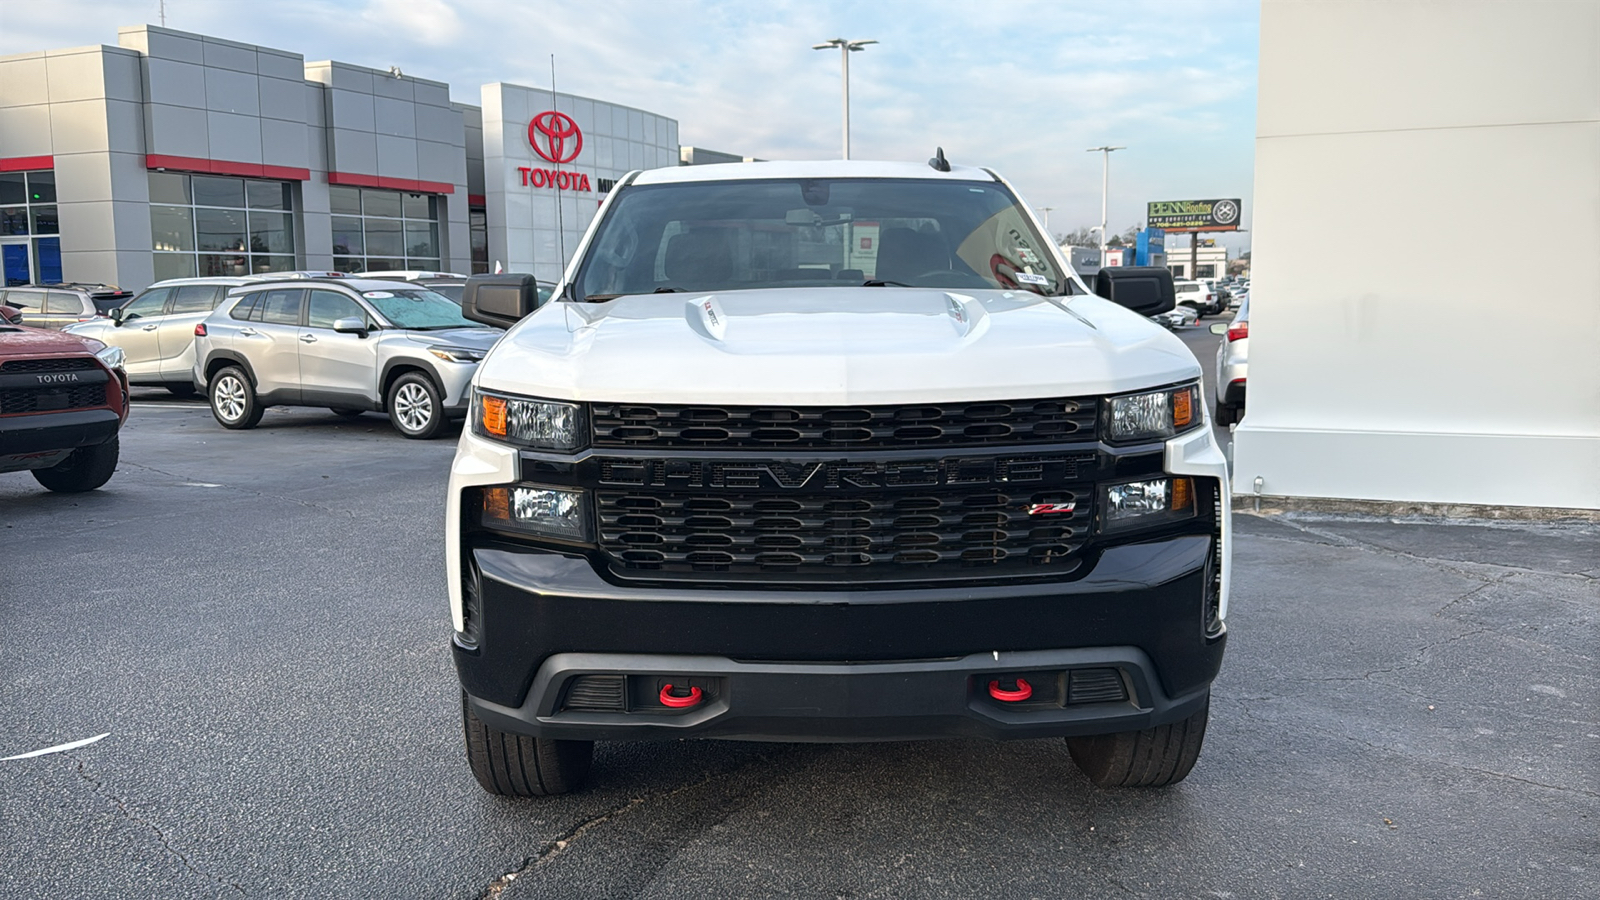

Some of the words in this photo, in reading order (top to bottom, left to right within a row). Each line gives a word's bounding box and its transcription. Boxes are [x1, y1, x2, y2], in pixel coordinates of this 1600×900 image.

[518, 166, 591, 192] TOYOTA
[37, 373, 78, 383] TOYOTA
[599, 454, 1097, 488] CHEVROLET
[1028, 502, 1076, 515] Z71
